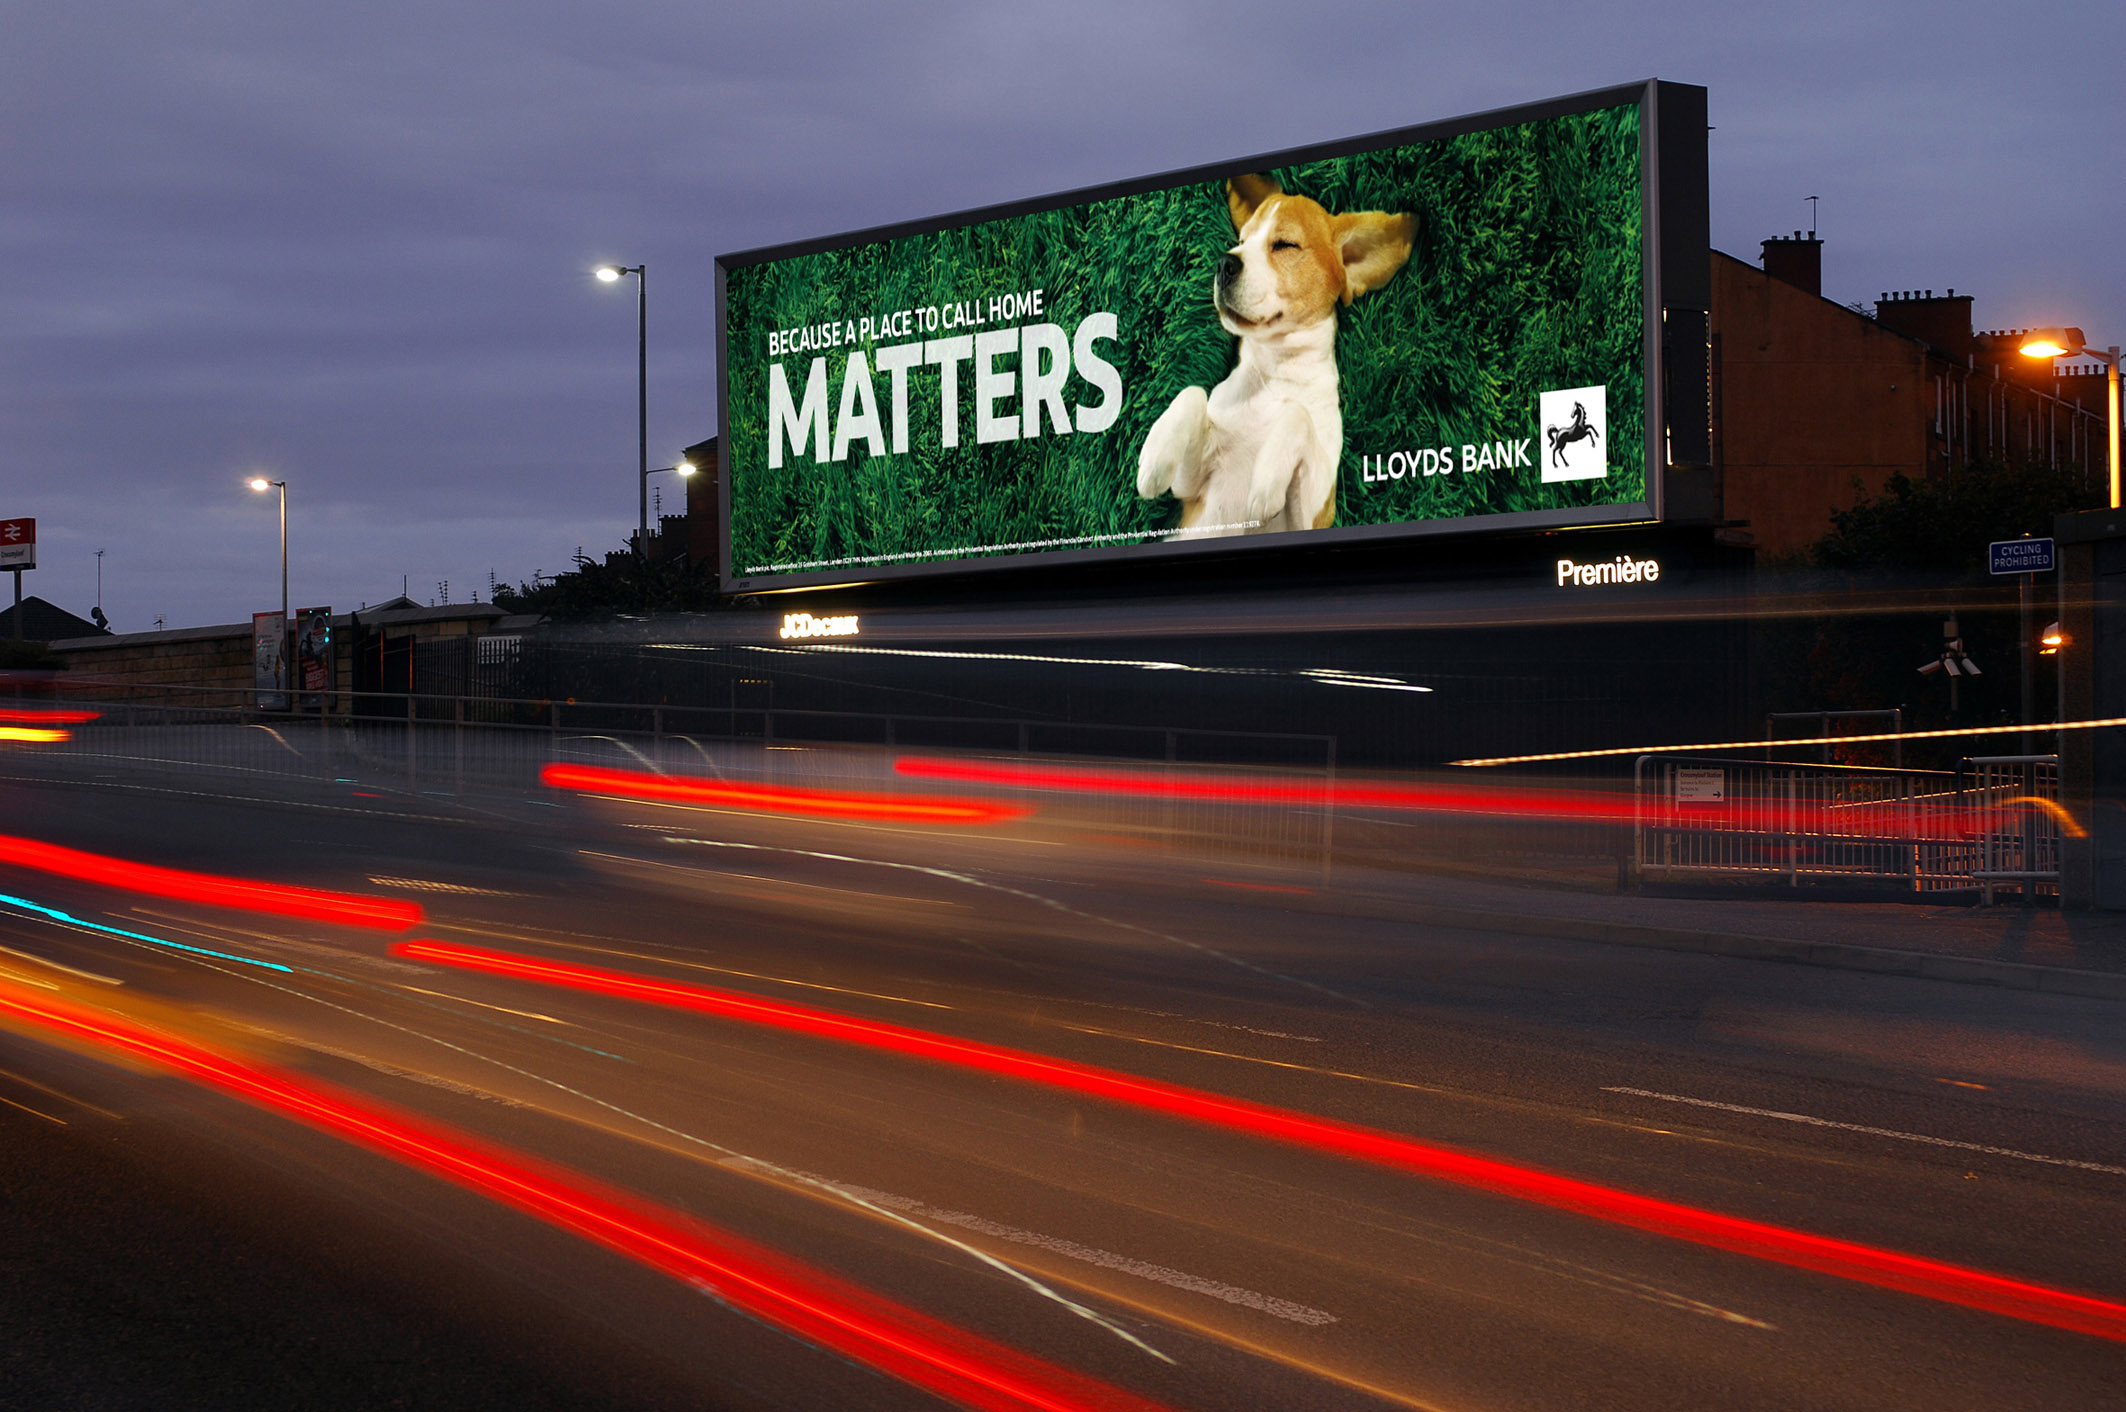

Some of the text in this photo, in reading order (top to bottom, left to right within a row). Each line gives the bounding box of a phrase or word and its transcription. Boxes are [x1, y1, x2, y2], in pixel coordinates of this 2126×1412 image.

[769, 289, 1044, 356] BECAUSE A PLACE TO CALL HOME
[768, 311, 1123, 469] MATTERS
[1363, 438, 1532, 482] LLOYDS BANK
[1994, 554, 2050, 568] PROHIBITED
[2001, 544, 2042, 556] CYCLING
[1557, 555, 1659, 586] Première
